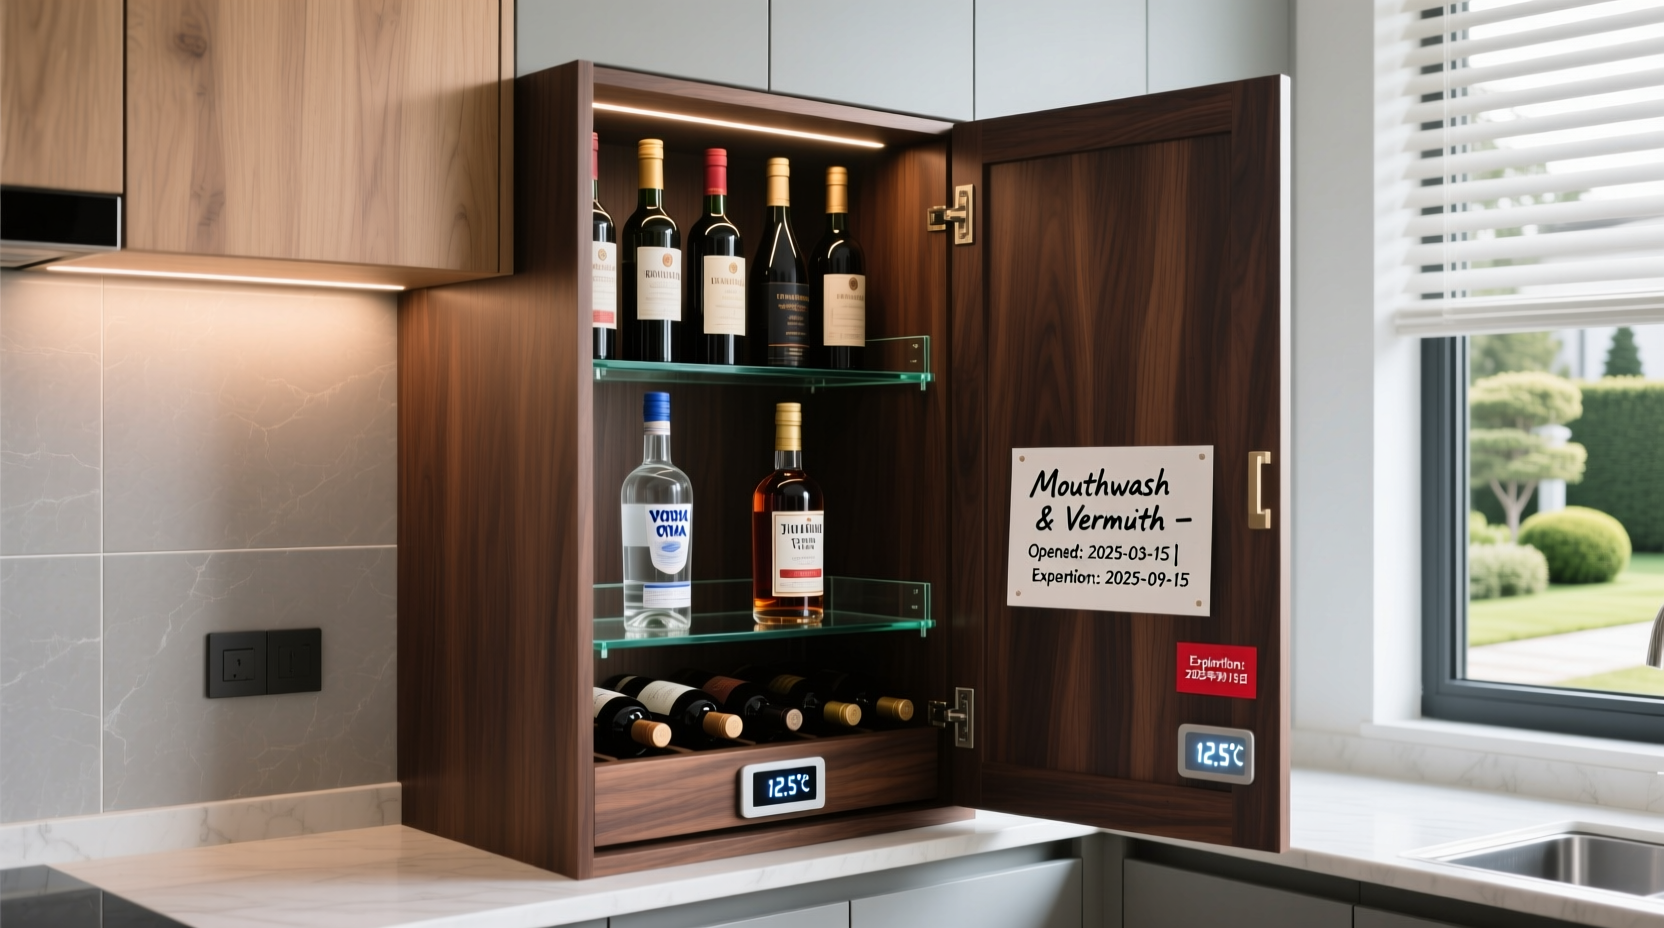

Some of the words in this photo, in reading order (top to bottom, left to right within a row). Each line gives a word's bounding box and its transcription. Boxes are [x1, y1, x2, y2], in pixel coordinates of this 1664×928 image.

[1029, 467, 1170, 498] Mouthwash
[1035, 505, 1054, 531] &
[1028, 543, 1083, 561] Opened:
[1087, 545, 1171, 561] 2025-03-15
[1104, 570, 1190, 587] 2025-09-15
